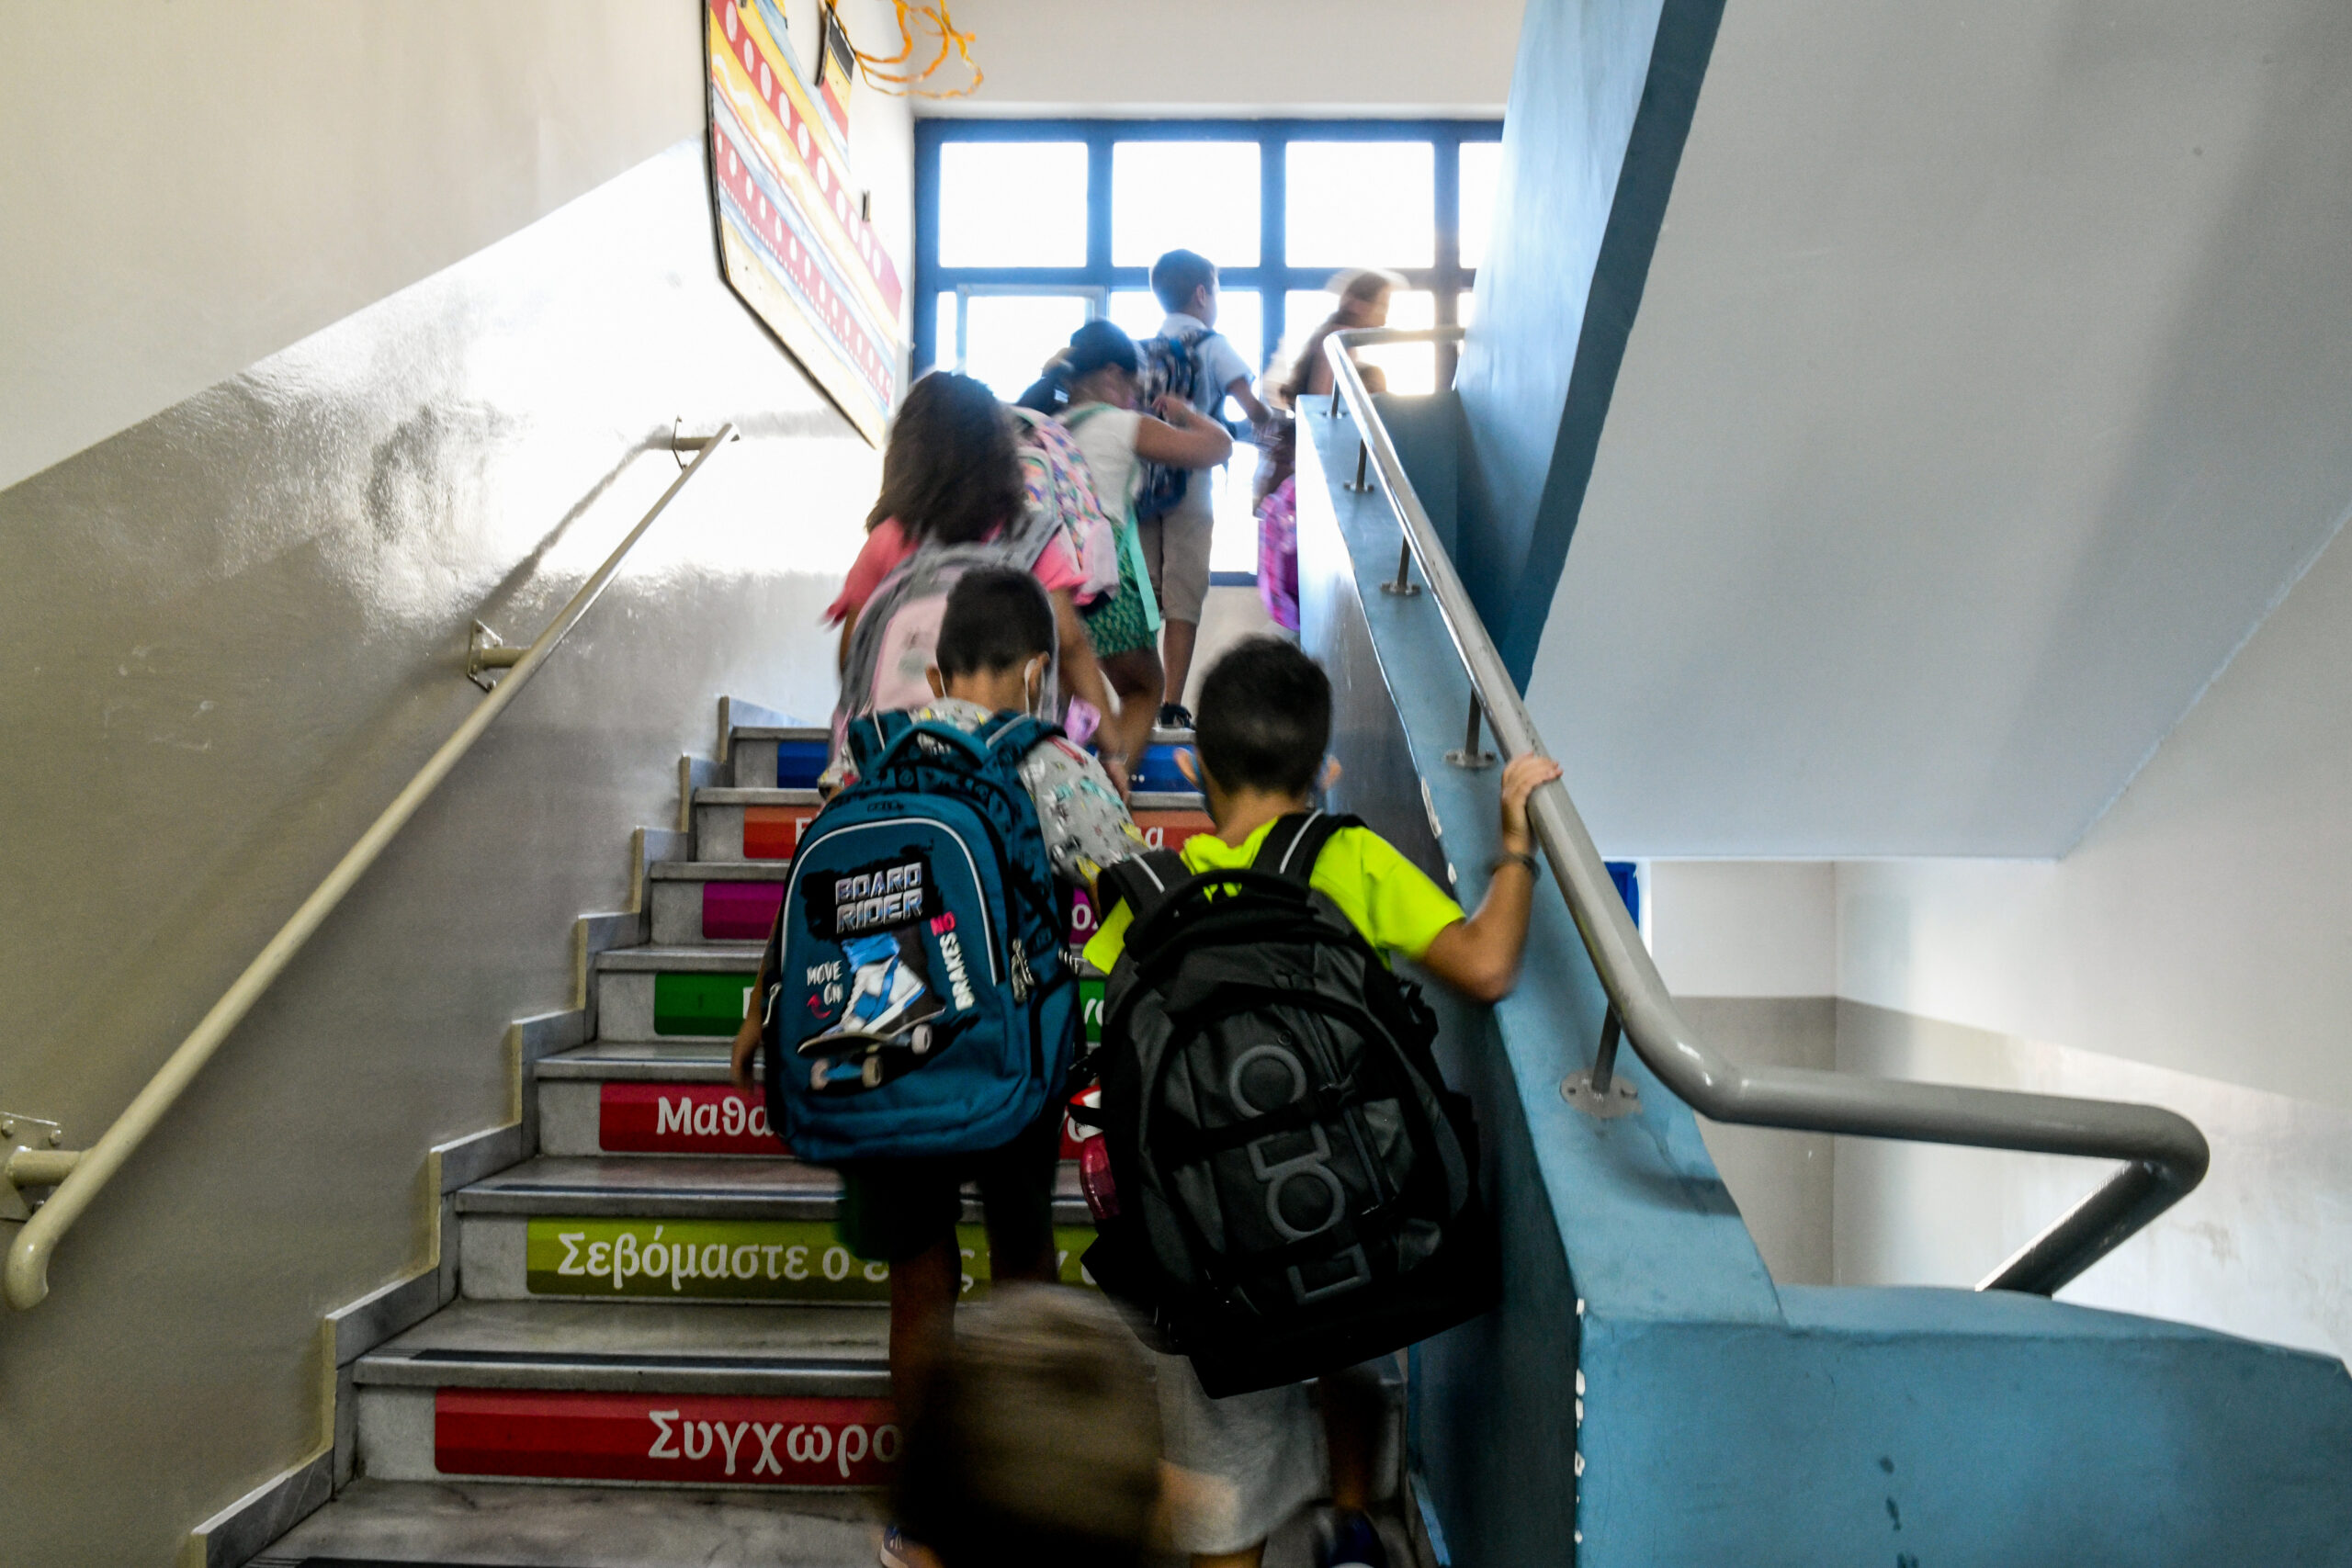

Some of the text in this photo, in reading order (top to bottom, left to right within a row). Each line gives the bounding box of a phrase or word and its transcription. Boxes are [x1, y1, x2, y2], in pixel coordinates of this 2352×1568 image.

[835, 862, 923, 902] BOARD
[836, 888, 924, 933] RIDER
[931, 911, 956, 936] NO
[806, 961, 842, 986] MOVE
[823, 983, 843, 1004] ON
[656, 1097, 775, 1137] Μαθα
[557, 1226, 808, 1291] Σεβόμαστε
[820, 1249, 850, 1280] ο
[648, 1409, 904, 1477] Συγχωρο
